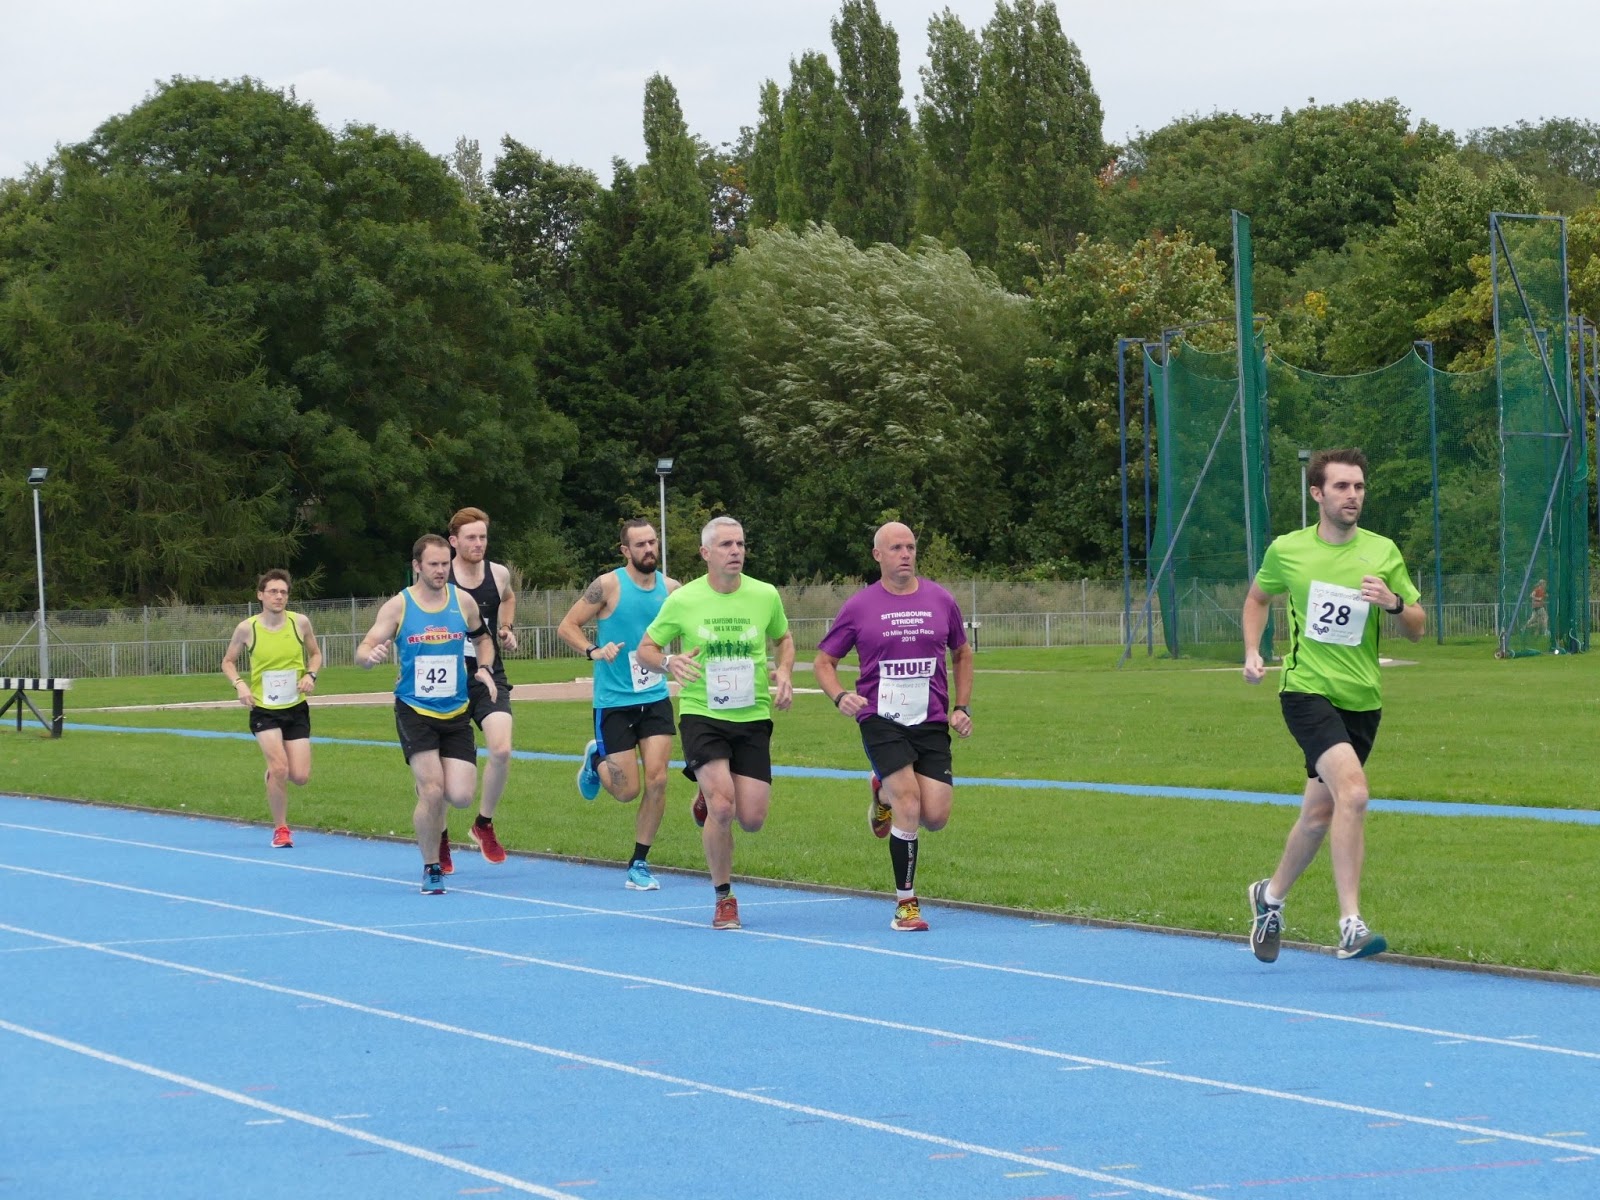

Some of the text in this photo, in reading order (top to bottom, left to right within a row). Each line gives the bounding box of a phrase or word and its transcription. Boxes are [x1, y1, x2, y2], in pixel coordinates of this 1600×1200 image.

[881, 610, 933, 620] SITTINGBOURNE
[1319, 601, 1352, 626] 28
[891, 618, 924, 626] STRIDERS
[407, 632, 464, 644] REFRESHERS
[903, 628, 919, 636] Road
[883, 661, 932, 676] THULE
[426, 668, 447, 684] 42
[717, 674, 738, 692] 51
